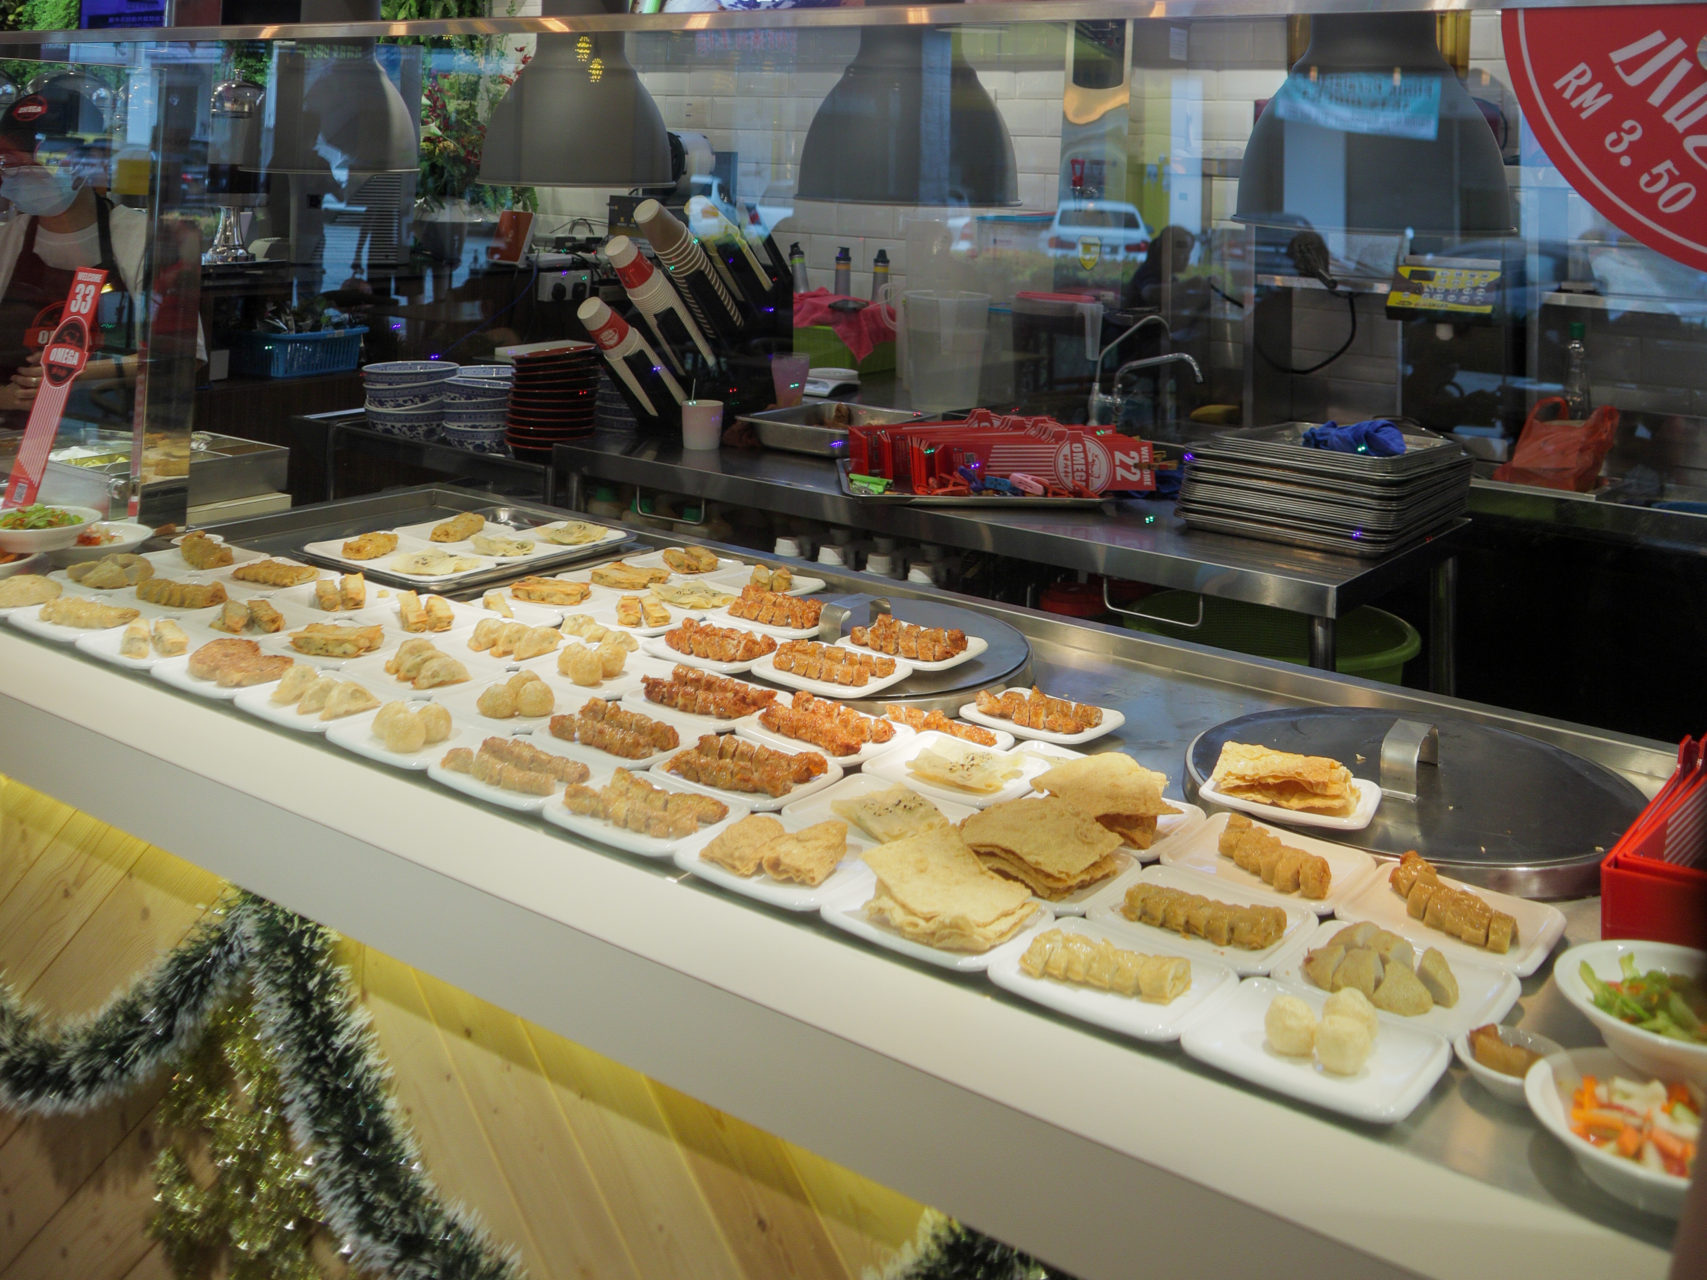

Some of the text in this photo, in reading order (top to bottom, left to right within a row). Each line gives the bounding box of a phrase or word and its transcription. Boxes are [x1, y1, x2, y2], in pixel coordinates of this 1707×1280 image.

[1552, 62, 1614, 120] RM
[70, 283, 96, 314] 33
[49, 347, 80, 366] OMEGA
[1114, 451, 1141, 482] 22
[1141, 446, 1153, 486] WELOME
